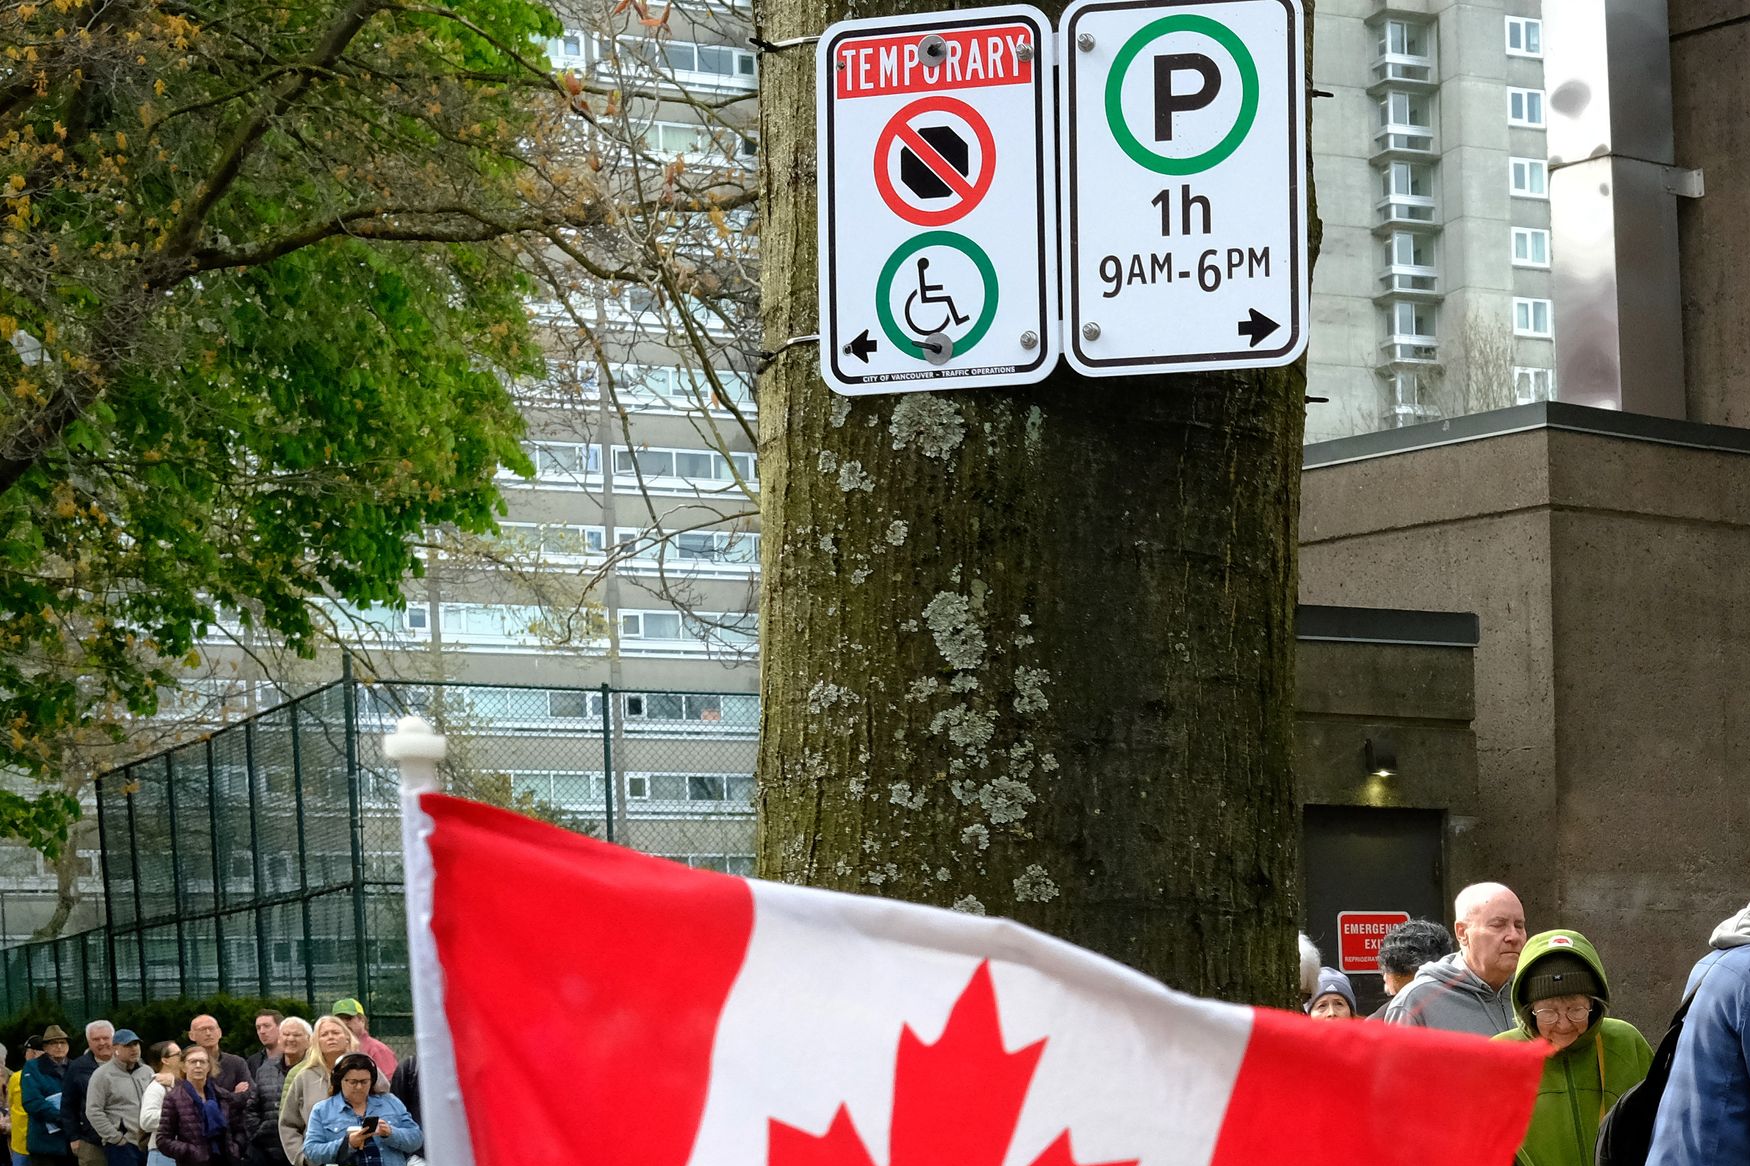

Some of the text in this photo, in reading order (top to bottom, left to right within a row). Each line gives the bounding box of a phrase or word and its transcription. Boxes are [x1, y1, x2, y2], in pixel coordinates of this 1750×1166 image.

[1154, 52, 1222, 142] P
[1151, 184, 1211, 237] 1h
[1099, 246, 1270, 298] 9AM-6PM
[879, 374, 890, 382] OF
[891, 372, 934, 381] VANCOUVER
[941, 369, 970, 378] TRAFFIC
[971, 366, 1016, 376] OPERATIONS
[1364, 938, 1384, 950] EXI
